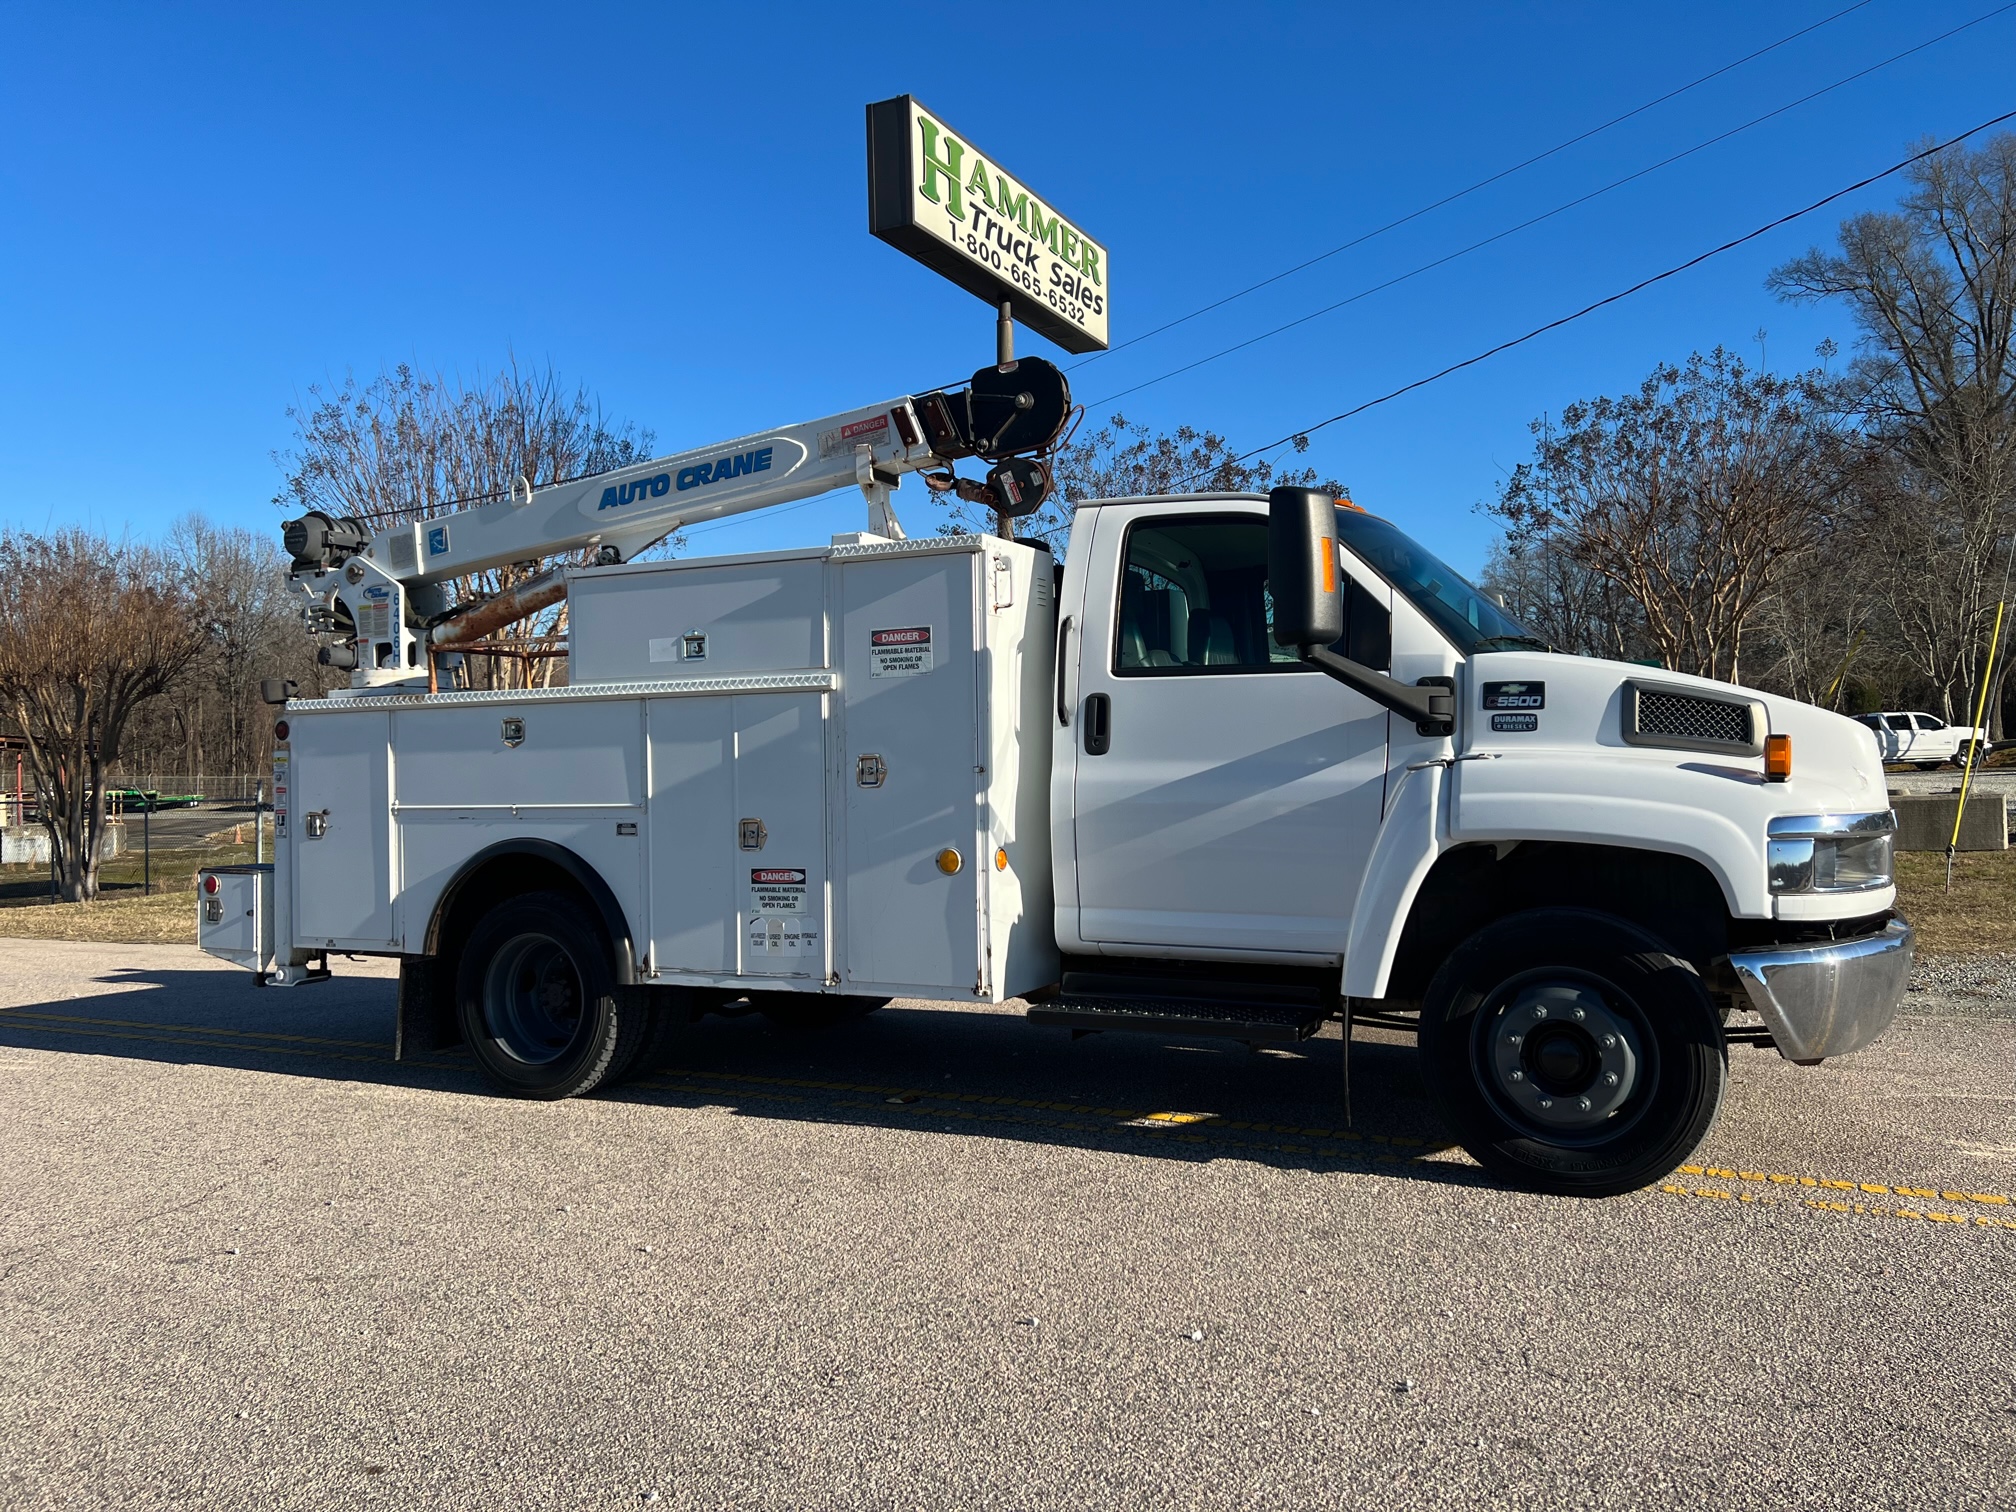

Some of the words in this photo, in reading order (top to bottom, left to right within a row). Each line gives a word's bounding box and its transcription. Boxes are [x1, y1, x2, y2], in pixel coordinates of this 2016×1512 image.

[918, 115, 1102, 286] HAMMER
[969, 201, 1040, 273] Truck
[1049, 262, 1104, 316] Sales
[949, 219, 1085, 326] 1-800-665-6532
[853, 418, 885, 434] DANGER
[597, 473, 670, 511] AUTO
[676, 446, 773, 491] CRANE
[881, 632, 920, 642] DANGER
[871, 647, 904, 656] FLAMMABLE
[904, 646, 931, 654] MATERIAL
[889, 656, 913, 664] SMOKING
[1494, 715, 1536, 723] DURAMAX
[760, 872, 797, 881] DANGER
